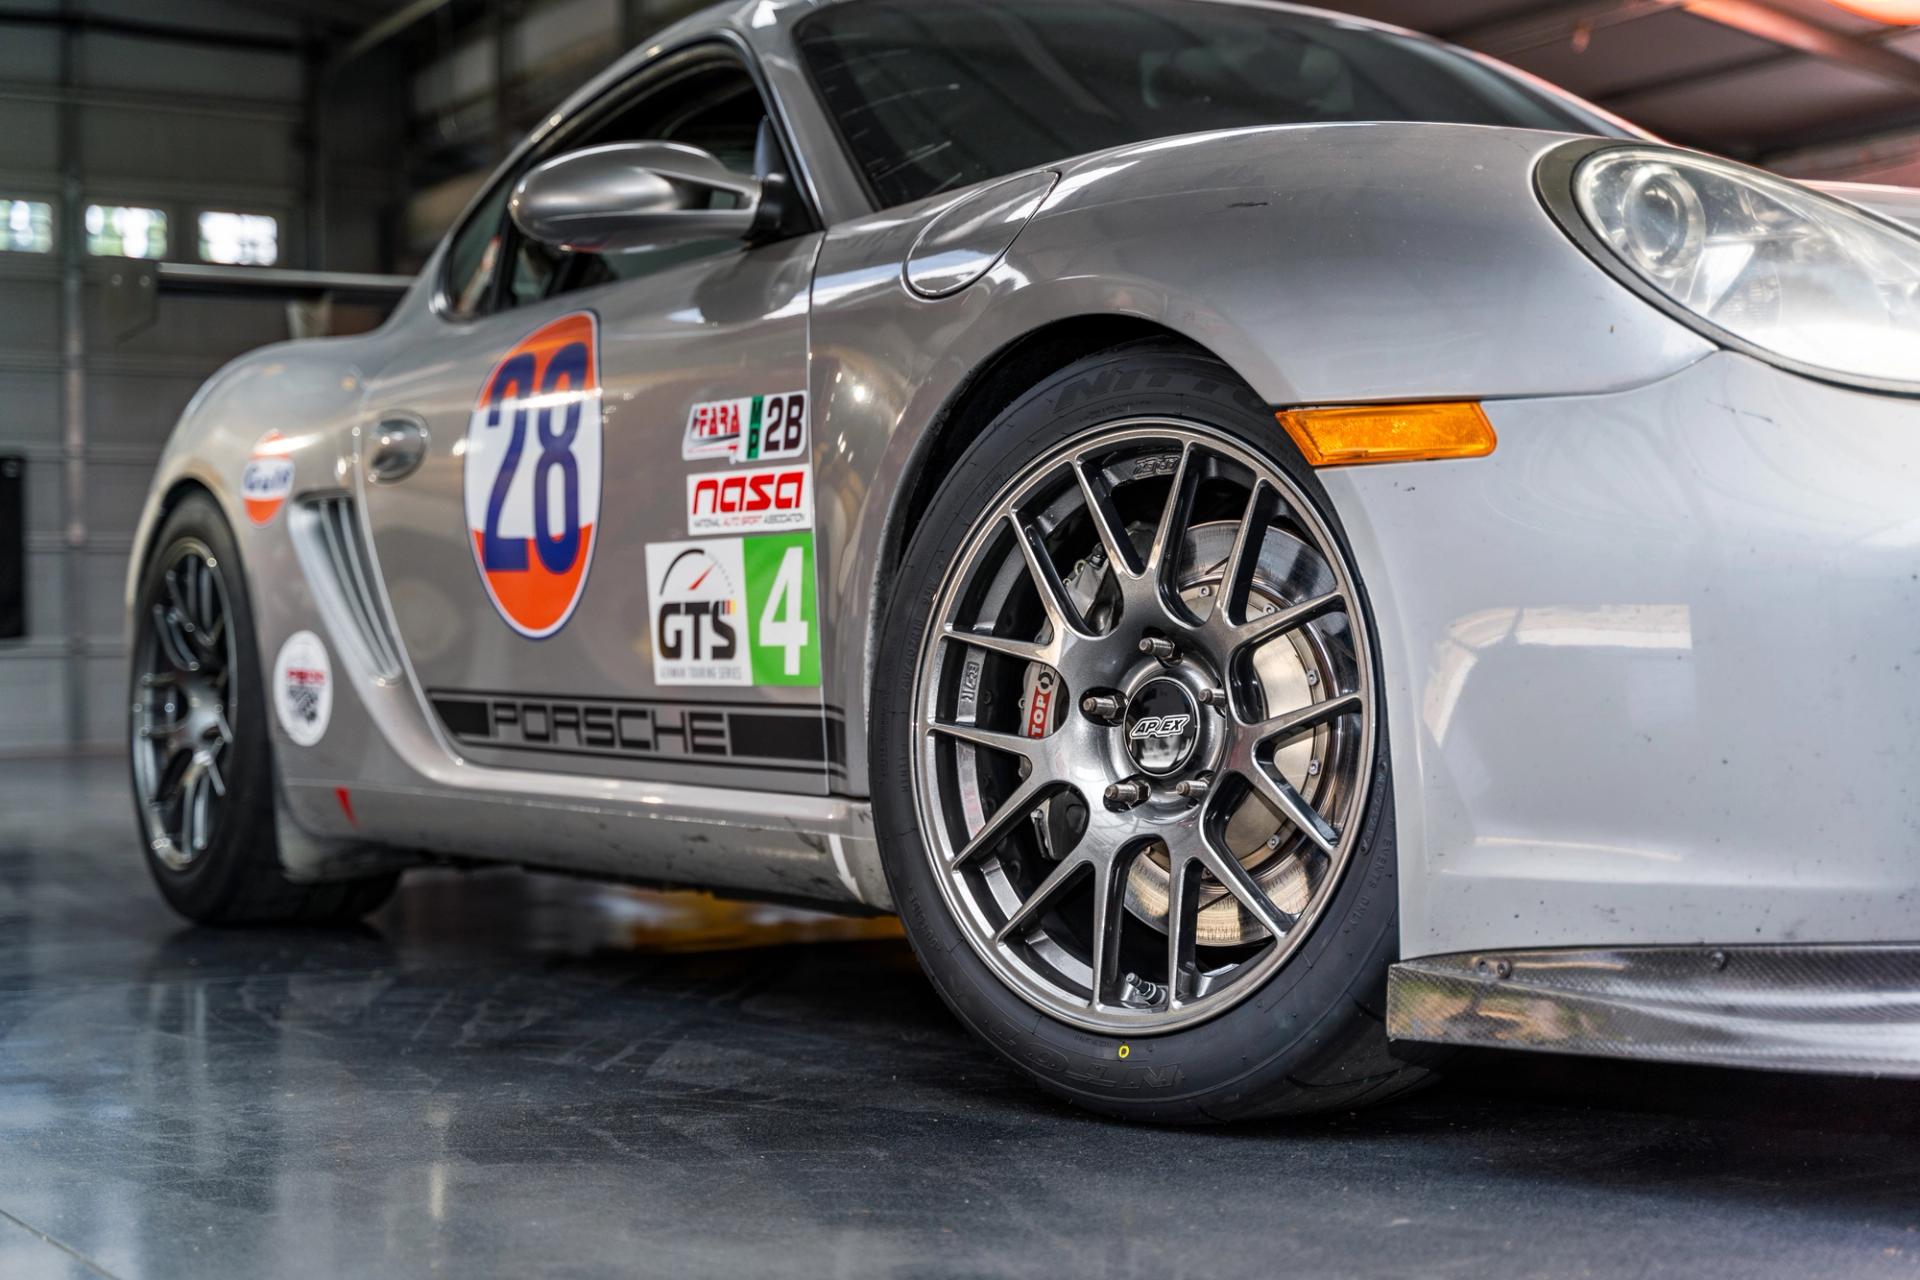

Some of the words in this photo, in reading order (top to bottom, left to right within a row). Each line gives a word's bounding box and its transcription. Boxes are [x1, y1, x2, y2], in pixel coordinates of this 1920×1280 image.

[698, 404, 740, 436] FARA
[764, 394, 805, 453] 2B
[484, 342, 589, 575] 28
[658, 600, 736, 660] GTS
[759, 546, 808, 676] 4
[493, 702, 728, 756] PORSCHE
[1031, 694, 1047, 735] TOP
[1131, 717, 1186, 736] APEX
[1368, 838, 1393, 889] EVENTS
